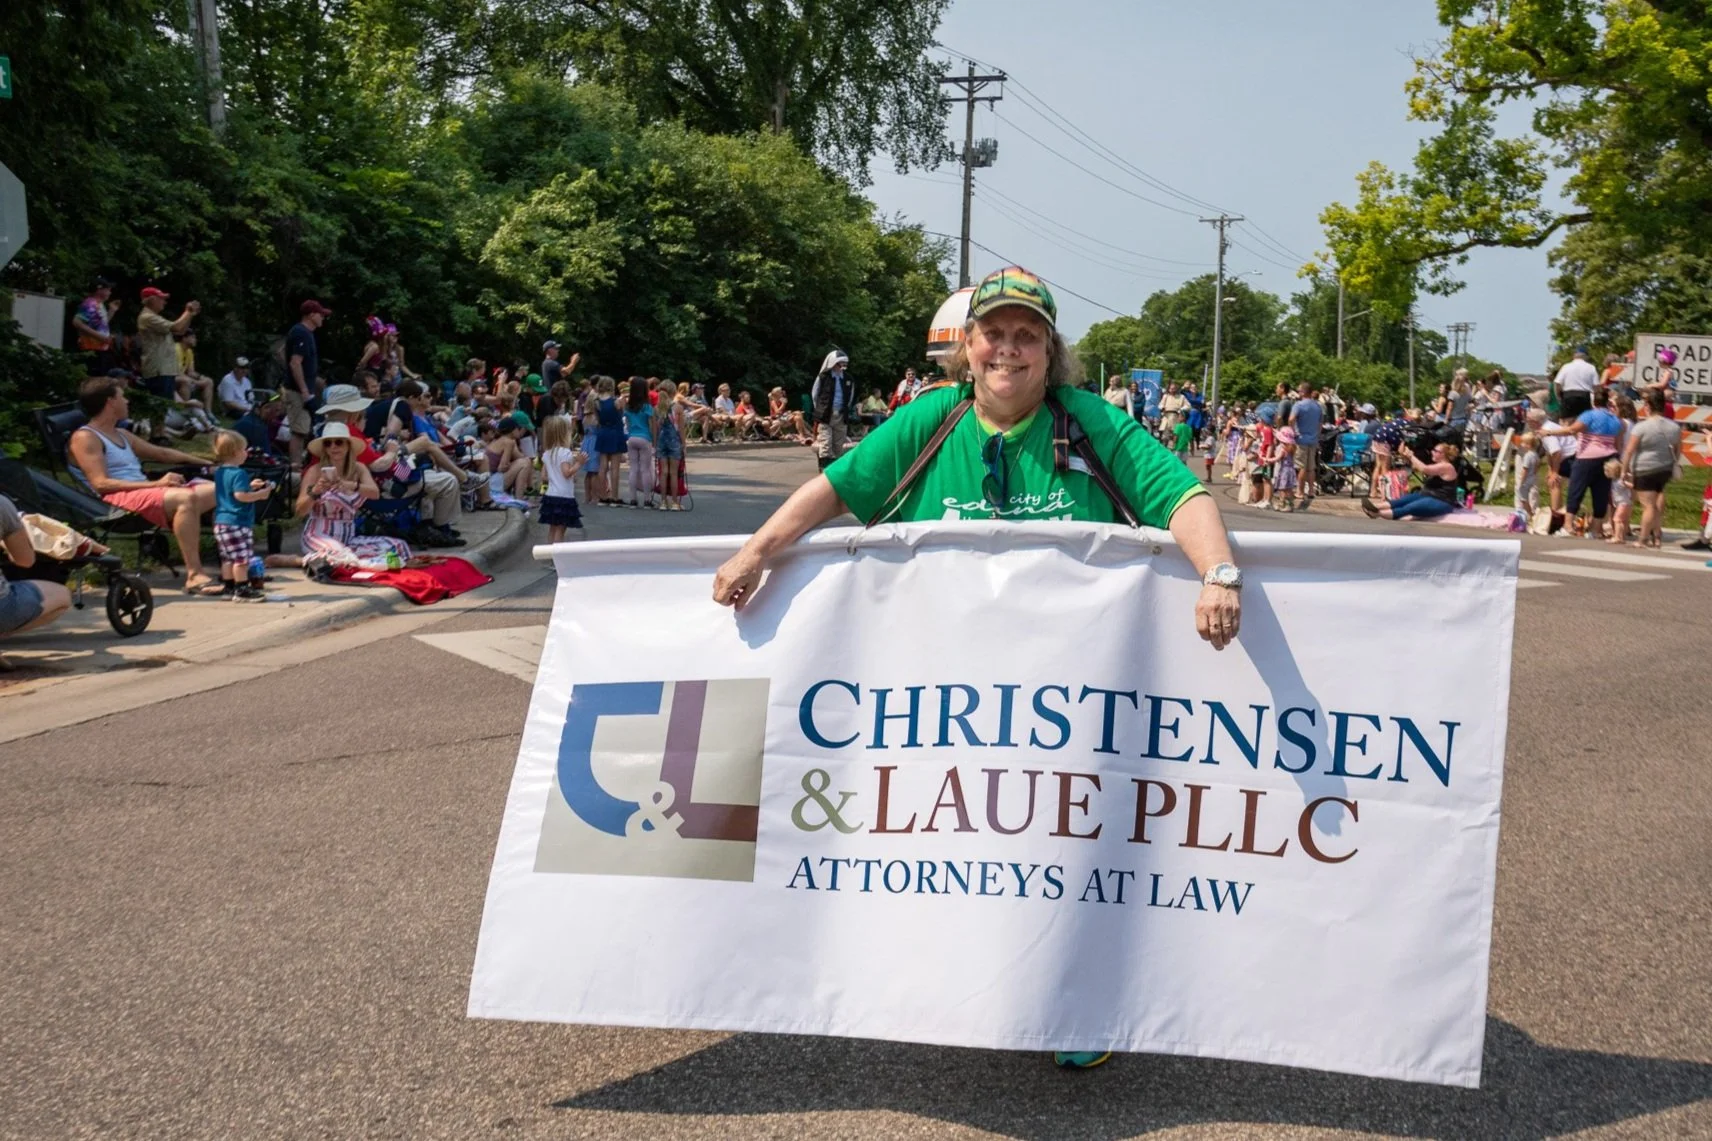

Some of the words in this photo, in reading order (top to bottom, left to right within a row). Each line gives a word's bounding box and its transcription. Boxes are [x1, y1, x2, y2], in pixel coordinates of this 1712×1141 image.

[1009, 493, 1041, 505] city
[1048, 488, 1066, 501] of
[799, 679, 1461, 787] CHRISTENSEN
[869, 765, 1103, 840] LAUE
[1127, 778, 1359, 864] PLLC
[786, 856, 1064, 900] ATTORNEYS
[1078, 867, 1135, 905] AT
[1147, 873, 1255, 916] LAW
